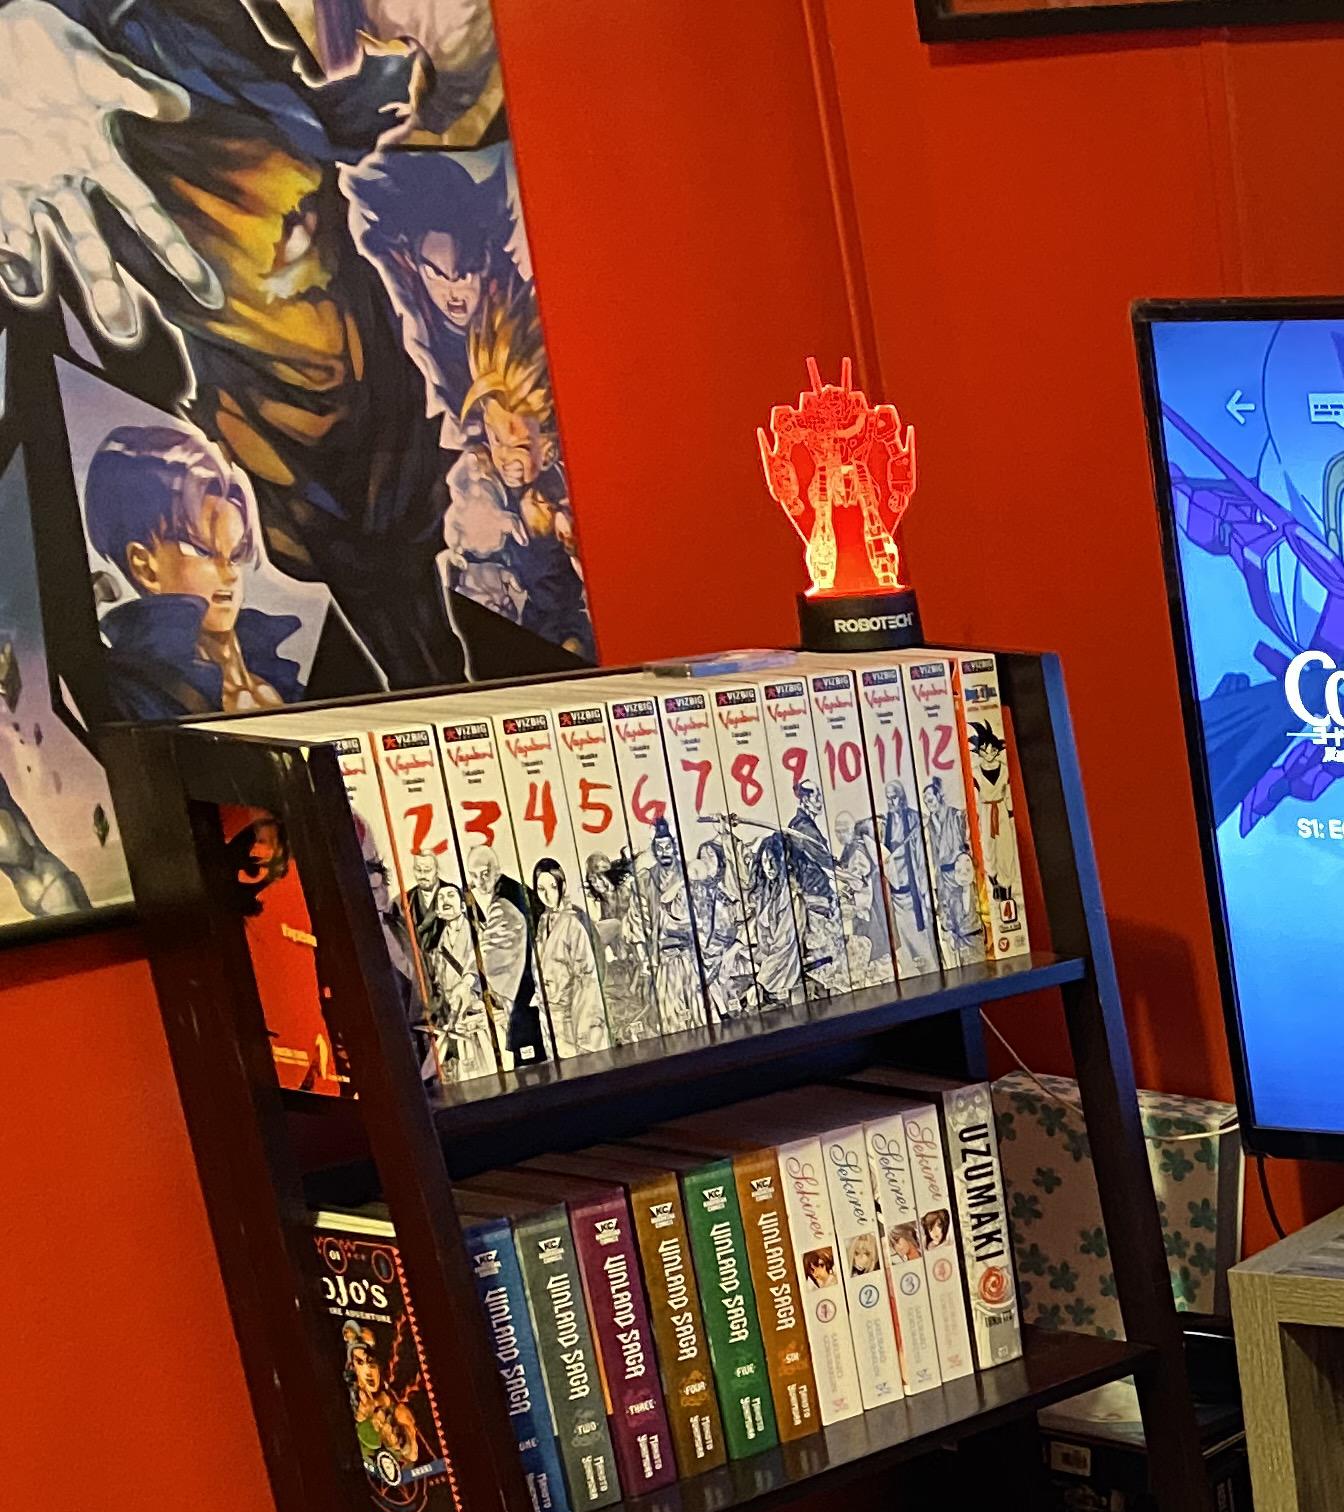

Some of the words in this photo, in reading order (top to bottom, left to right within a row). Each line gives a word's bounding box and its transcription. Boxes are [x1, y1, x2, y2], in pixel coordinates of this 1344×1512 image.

[833, 612, 914, 633] ROBOTECH
[514, 714, 547, 729] VIZBIG
[570, 709, 601, 722] VIZBIG
[623, 702, 653, 715] VIZBIG
[674, 694, 705, 707] VIZBIG
[726, 690, 755, 703] VIZBIG
[396, 732, 428, 745] VIZBIG
[454, 723, 488, 738] VIZBIG
[873, 727, 902, 784] 11
[919, 724, 955, 777] 12
[682, 759, 713, 817] 7
[731, 753, 764, 807] 8
[782, 746, 809, 789] 9
[824, 739, 862, 790] 10
[461, 801, 502, 848] 3
[524, 780, 557, 846] 4
[579, 778, 613, 834] 5
[631, 774, 666, 826] 6
[404, 803, 449, 856] 2
[1296, 817, 1325, 839] S1:
[1003, 900, 1013, 920] 4
[958, 1123, 1005, 1262] UZUMAKI
[710, 1222, 741, 1294] VINLAND
[758, 1212, 788, 1283] VINLAND
[604, 1254, 636, 1328] VINLAND
[659, 1238, 689, 1310] VINLAND
[485, 1287, 519, 1362] VINLAND
[547, 1273, 580, 1348] VINLAND
[722, 1294, 749, 1343] SAGA
[770, 1282, 796, 1331] SAGA
[616, 1328, 645, 1380] SAGA
[671, 1311, 698, 1361] SAGA
[501, 1364, 531, 1416] SAGA
[560, 1349, 590, 1400] SAGA
